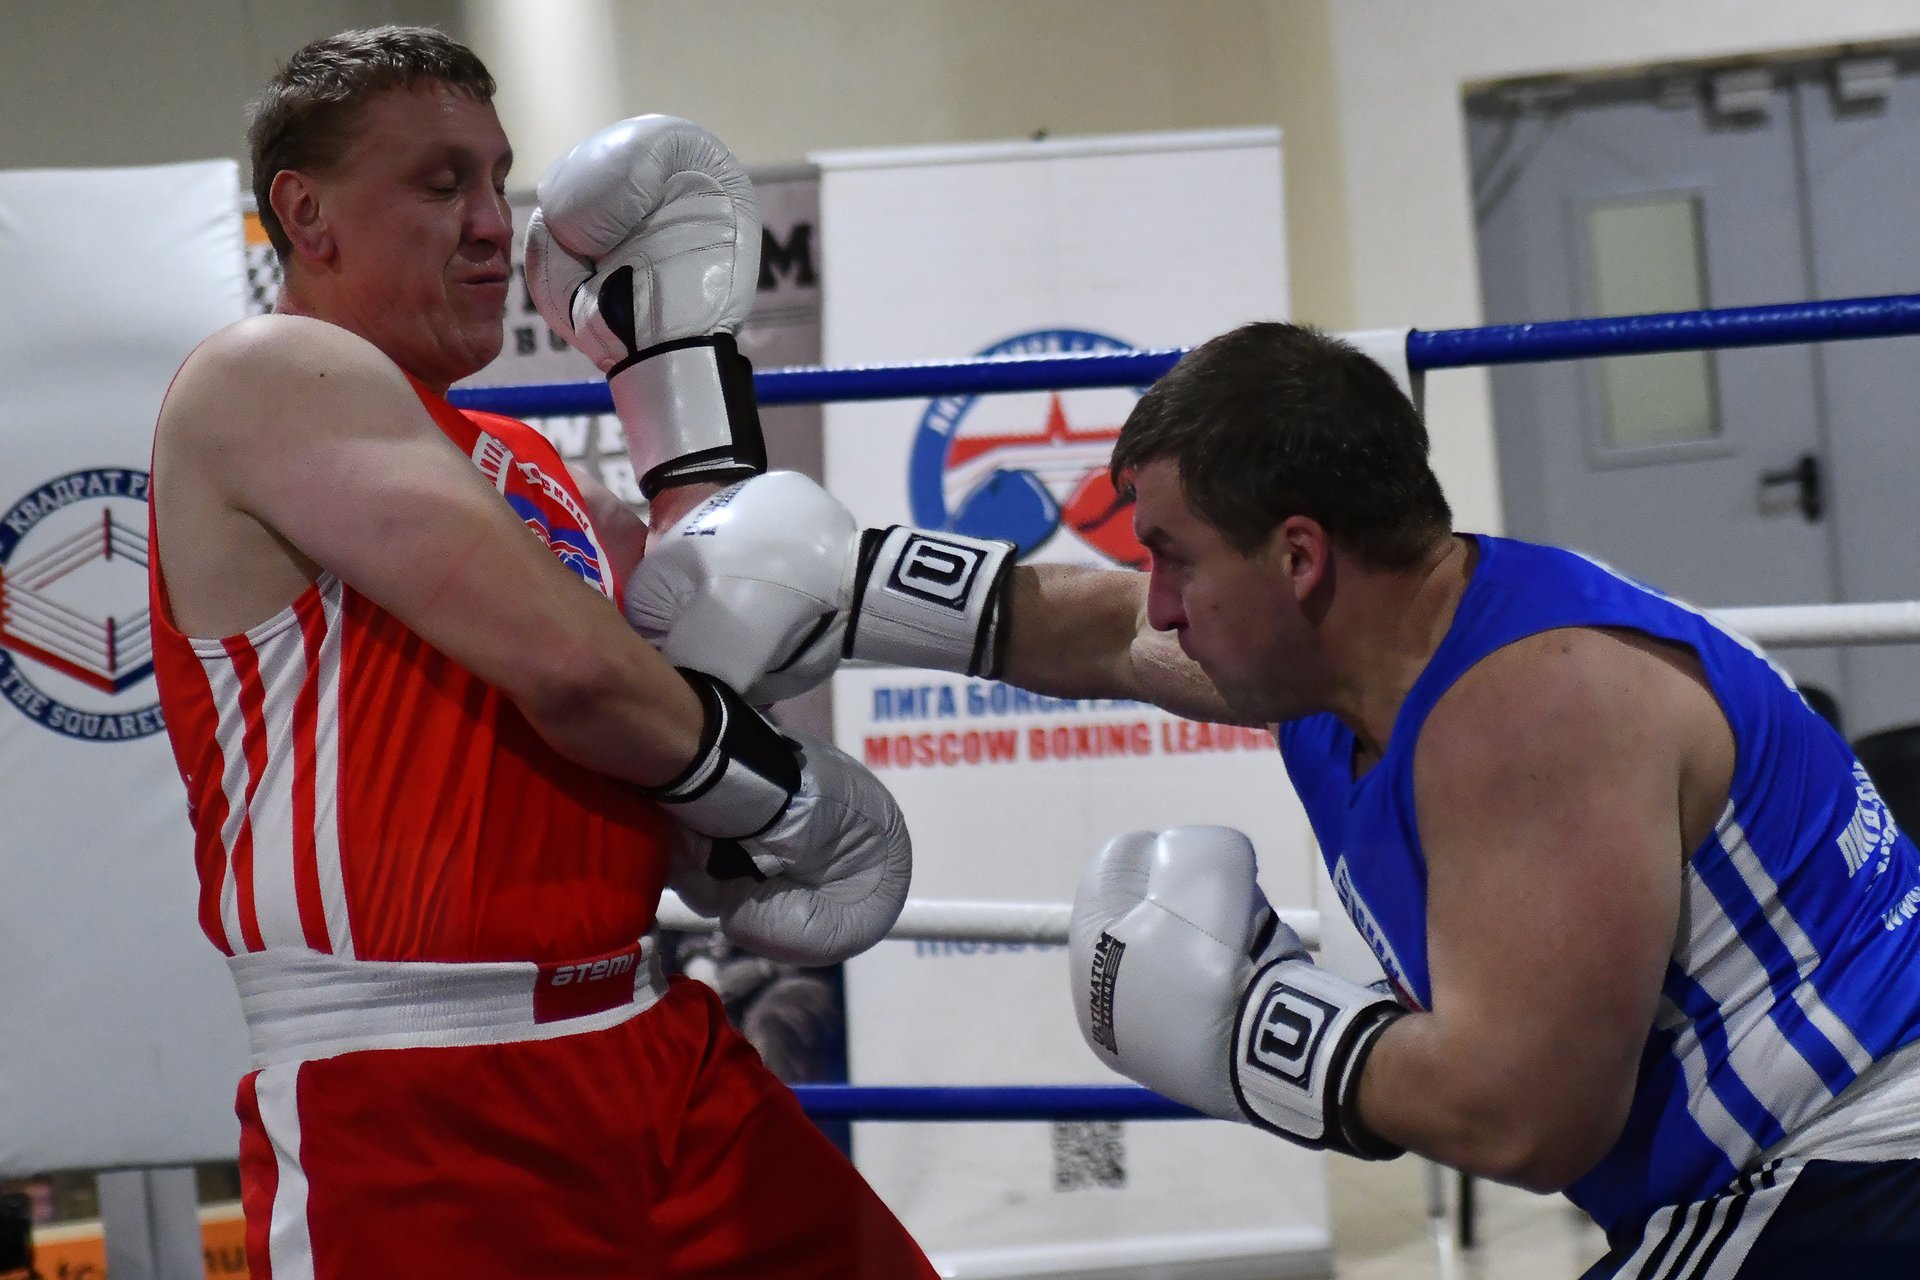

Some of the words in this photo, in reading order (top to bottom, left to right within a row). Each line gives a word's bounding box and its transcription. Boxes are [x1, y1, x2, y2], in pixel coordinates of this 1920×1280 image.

[902, 541, 972, 596] U
[2, 667, 48, 715] THE
[873, 685, 957, 721] ЛИГА
[864, 731, 1018, 768] MOSCOW
[1029, 722, 1152, 761] BOXING
[1257, 996, 1320, 1070] U
